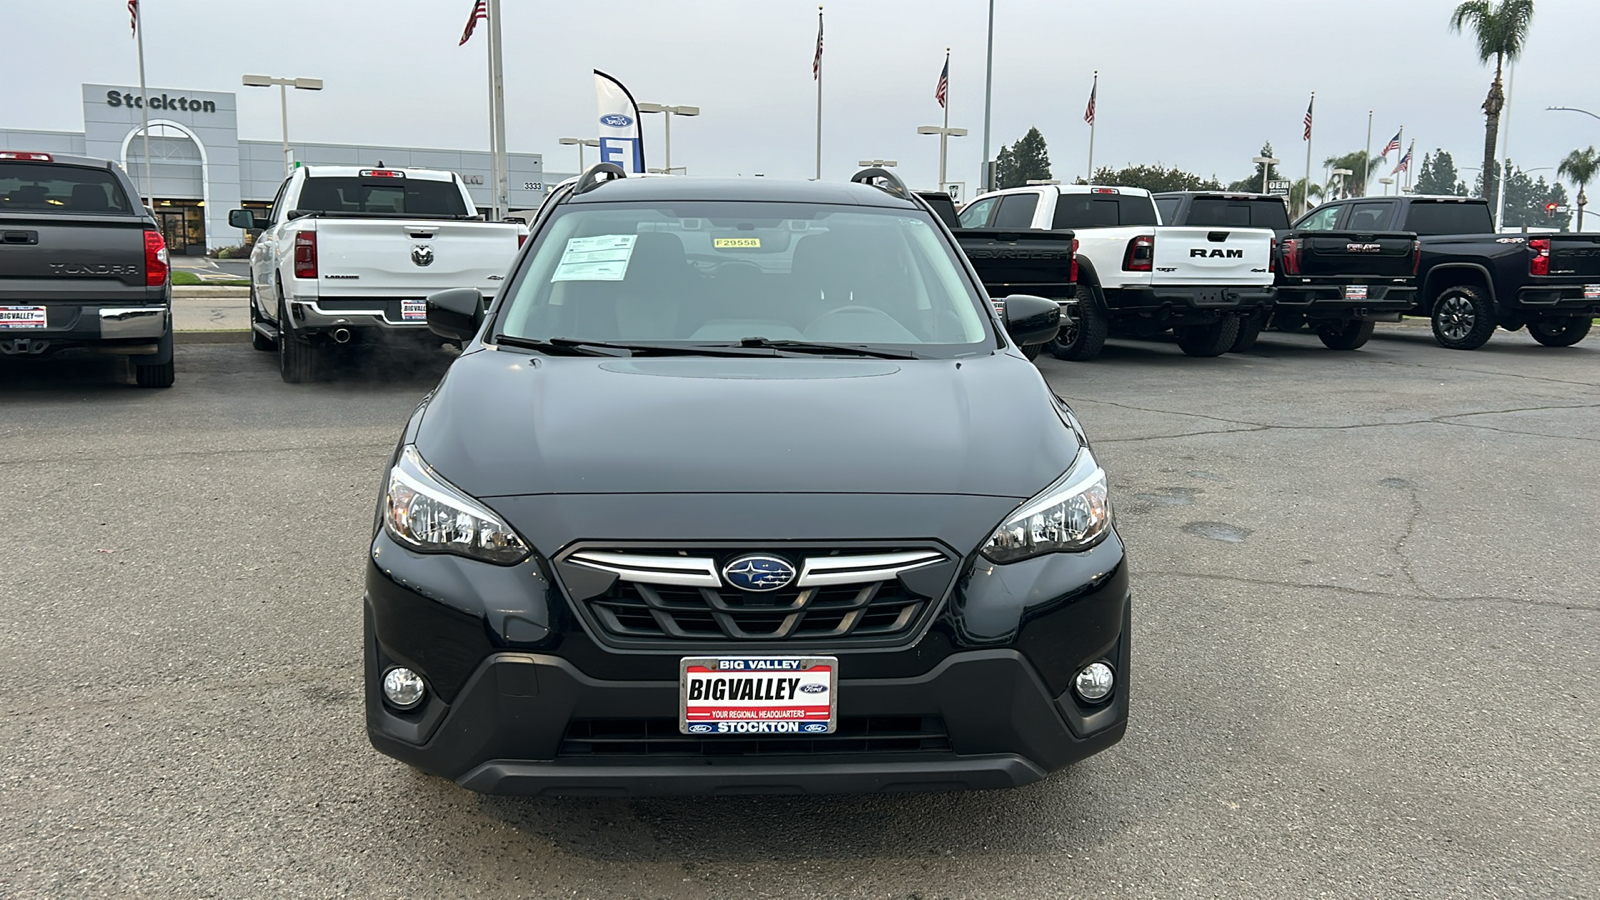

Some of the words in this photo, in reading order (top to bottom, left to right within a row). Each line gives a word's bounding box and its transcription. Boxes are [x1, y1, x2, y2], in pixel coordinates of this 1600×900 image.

[106, 90, 216, 113] Stockton
[524, 182, 542, 190] 3333
[1268, 181, 1289, 189] OEM
[966, 249, 1071, 259] HEVROLET
[1190, 249, 1243, 258] RAM
[50, 263, 139, 275] TUNDRA
[719, 660, 745, 669] BIG
[748, 660, 800, 669] VALLEY
[688, 678, 801, 701] BIGVALLEY
[711, 710, 729, 718] YOUR
[729, 710, 758, 718] REGIONAL
[758, 710, 805, 718] HEADQUARTERS
[717, 721, 799, 733] STOCKTON
